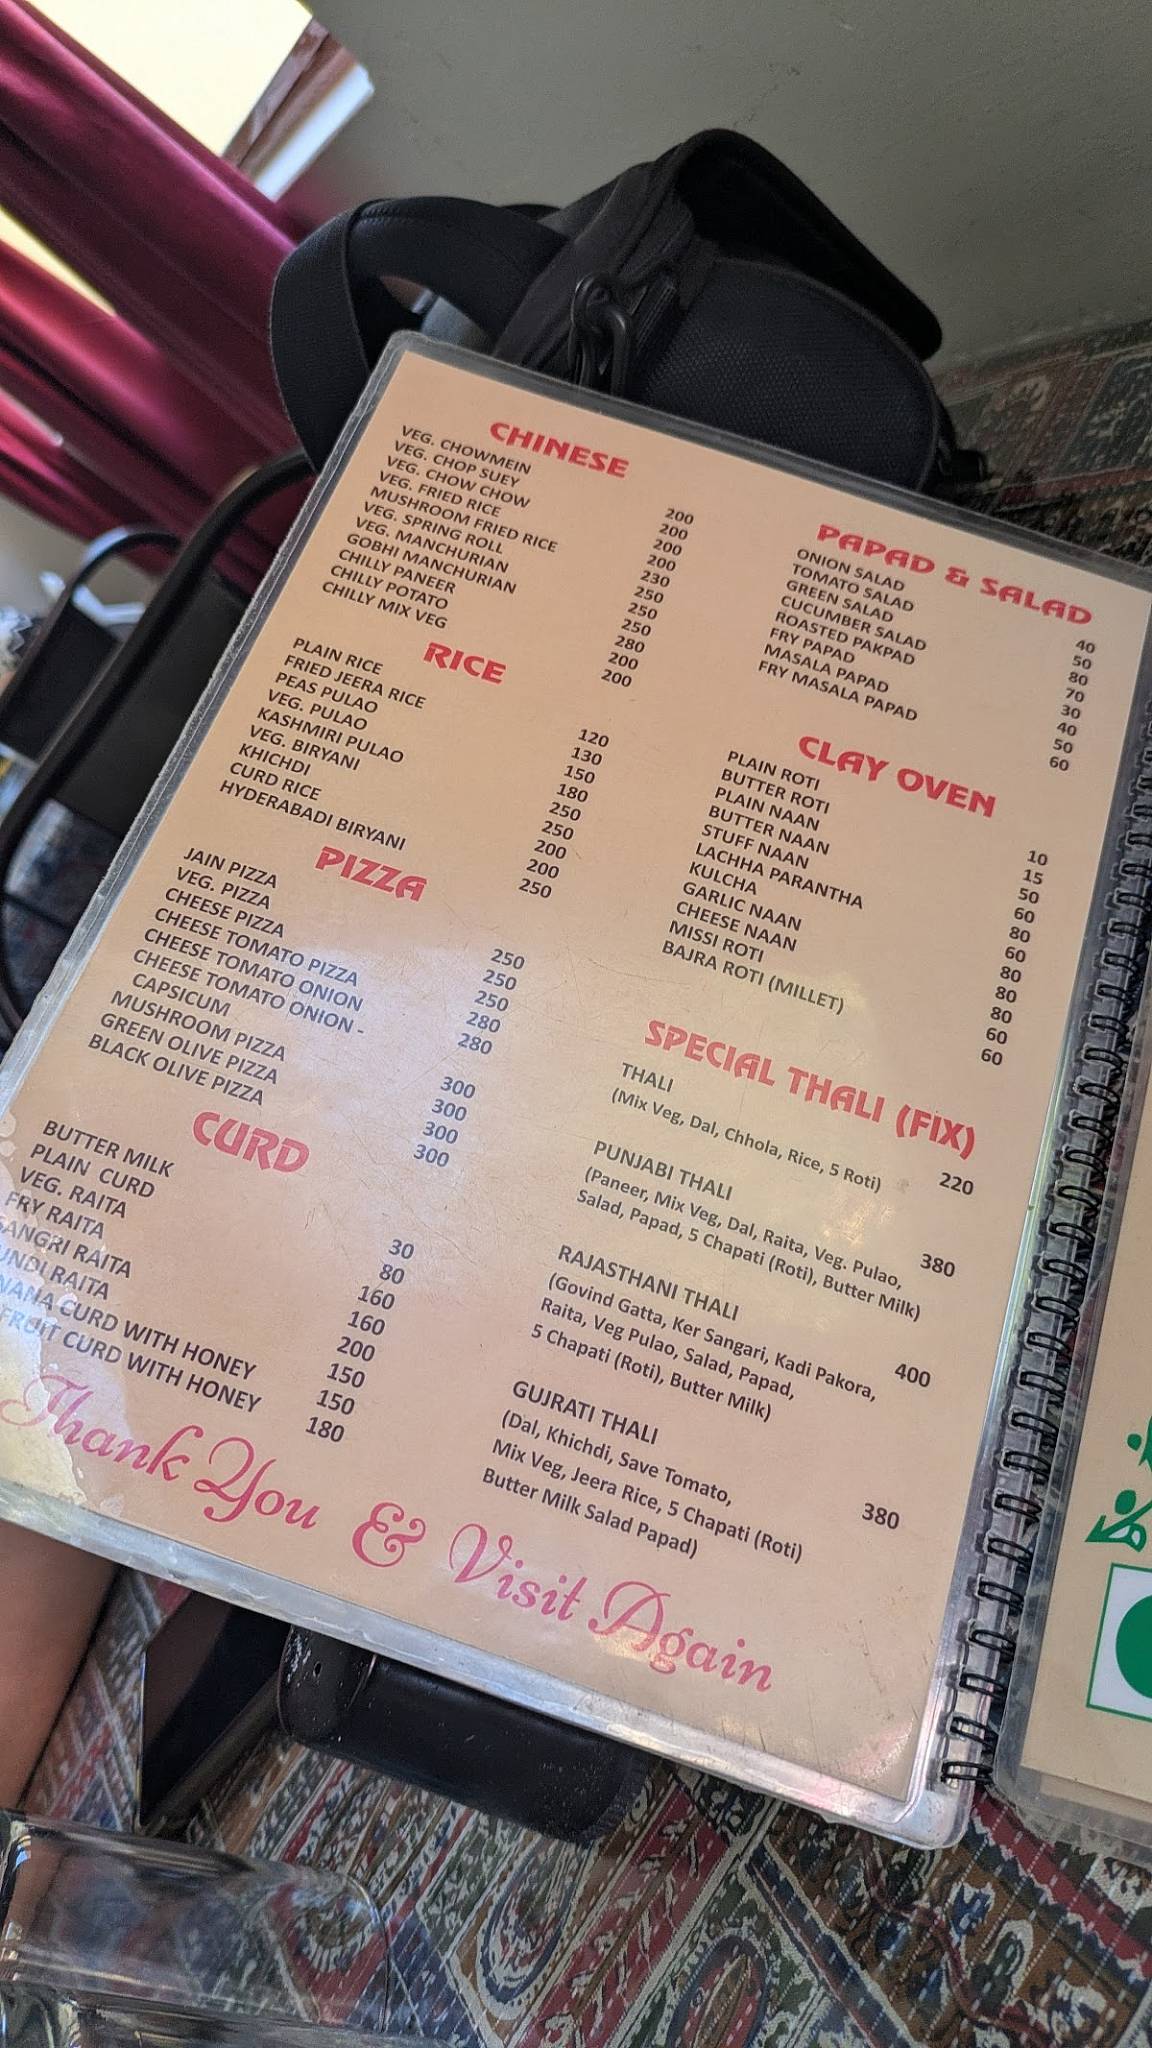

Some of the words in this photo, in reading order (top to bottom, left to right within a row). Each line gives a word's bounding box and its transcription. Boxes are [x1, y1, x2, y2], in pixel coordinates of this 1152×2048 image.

[402, 424, 435, 446] VEG.
[440, 439, 532, 475] CHOWMEIN
[489, 421, 630, 479] CHINESE
[387, 455, 420, 476] VEG.
[425, 468, 478, 492] CHOW
[479, 485, 531, 509] CHOW
[369, 485, 471, 526] MUSHROOM
[473, 517, 520, 540] FRIED
[521, 532, 558, 553] RICE
[664, 507, 695, 525] 200
[356, 516, 390, 538] VEG.
[394, 529, 510, 574] MANCHURIAN
[652, 538, 683, 556] 200
[338, 548, 392, 573] CHILLY
[392, 565, 457, 595] PANEER
[639, 569, 671, 588] 230
[796, 548, 852, 575] ONION
[853, 567, 906, 592] SALAD
[816, 523, 936, 574] PAPAD
[944, 565, 971, 588] &
[979, 577, 1093, 625] SALAD
[322, 581, 376, 606] CHILLY
[376, 597, 413, 618] MIX
[415, 608, 448, 629] VEG
[627, 601, 658, 621] 250
[780, 595, 872, 634] CUCUMBER
[874, 625, 927, 651] SALAD
[292, 636, 343, 663] PLAIN
[344, 653, 384, 676] RICE
[614, 634, 646, 654] 280
[774, 610, 849, 644] ROASTED
[852, 636, 916, 666] PAKPAD
[1075, 639, 1096, 654] 40
[423, 641, 507, 685] RICE
[600, 668, 633, 688] 200
[274, 671, 319, 695] PEAS
[320, 685, 379, 714] PULAO
[758, 659, 790, 679] FRY
[791, 670, 860, 704] MASALA
[863, 694, 918, 721] PAPAD
[1065, 687, 1086, 703] 70
[1060, 704, 1082, 720] 30
[256, 706, 344, 744] KASHMIRI
[344, 735, 405, 763] PULAO
[577, 728, 610, 748] 120
[238, 742, 312, 776] KHICHDI
[563, 764, 596, 785] 150
[727, 750, 778, 777] PLAIN
[780, 767, 821, 792] ROTI
[798, 735, 890, 782] CLAY
[896, 767, 997, 819] OVEN
[1049, 755, 1070, 772] 60
[219, 779, 334, 827] HYDERABADI
[335, 817, 407, 851] BIRYANI
[548, 801, 582, 822] 250
[714, 786, 766, 814] PLAIN
[768, 804, 821, 832] NAAN
[533, 839, 567, 860] 200
[701, 823, 755, 850] STUFF
[757, 841, 810, 870] NAAN
[1027, 849, 1049, 867] 10
[183, 847, 227, 871] JAIN
[227, 861, 277, 889] PIZZA
[315, 845, 428, 902] PIZZA
[518, 877, 553, 899] 250
[688, 861, 757, 896] KULCHA
[165, 887, 233, 920] CHEESE
[233, 909, 284, 939] PIZZA
[1017, 887, 1040, 905] 50
[676, 900, 741, 933] CHEESE
[743, 923, 798, 952] NAAN
[1008, 925, 1031, 944] 80
[490, 948, 525, 970] 250
[661, 939, 717, 971] BAJRA
[722, 960, 765, 986] ROTI
[768, 975, 844, 1016] (MILLET)
[999, 965, 1023, 984] 80
[132, 973, 232, 1017] CAPSICUM
[474, 990, 509, 1012] 250
[989, 1006, 1013, 1025] 80
[110, 990, 232, 1043] MUSHROOM
[233, 1032, 285, 1062] PIZZA
[87, 1033, 151, 1067] BLACK
[152, 1056, 210, 1087] OLIVE
[210, 1075, 263, 1106] PIZZA
[622, 1062, 674, 1093] THALI
[980, 1048, 1004, 1066] 60
[440, 1076, 476, 1099] 300
[644, 1019, 776, 1087] SPECIAL
[787, 1066, 885, 1123] THALI
[895, 1104, 976, 1161] (FIX)
[431, 1098, 468, 1122] 300
[42, 1119, 120, 1160] BUTTER
[122, 1147, 175, 1178] MILK
[193, 1111, 310, 1173] CURD
[413, 1144, 450, 1168] 300
[611, 1087, 648, 1112] (Mix
[653, 1101, 685, 1127] Veg,
[689, 1114, 719, 1139] Dal,
[724, 1127, 783, 1160] Chhola,
[787, 1148, 824, 1175] Rice,
[828, 1162, 840, 1177] 5
[843, 1167, 881, 1194] Roti)
[593, 1140, 675, 1181] PUNJABI
[679, 1168, 733, 1201] THALI
[938, 1171, 975, 1196] 220
[20, 1165, 62, 1197] VEG.
[68, 1185, 127, 1219] RAITA
[5, 1191, 46, 1216] FRY
[45, 1205, 104, 1240] RAITA
[388, 1238, 415, 1260] 30
[576, 1189, 624, 1220] Salad,
[629, 1207, 683, 1240] Papad,
[688, 1227, 699, 1242] 5
[702, 1233, 766, 1266] Chapati
[768, 1254, 817, 1287] (Roti),
[822, 1274, 875, 1304] Butter
[878, 1293, 921, 1323] Milk)
[919, 1253, 956, 1278] 380
[357, 1285, 395, 1310] 160
[558, 1244, 679, 1300] RAJASTHANI
[684, 1287, 740, 1322] THALI
[347, 1310, 386, 1336] 160
[548, 1272, 615, 1308] (Govind
[617, 1298, 667, 1330] Gatta,
[672, 1316, 702, 1338] Ker
[703, 1327, 769, 1366] Sangari,
[774, 1352, 812, 1378] Kadi
[814, 1365, 876, 1403] Pakora,
[336, 1335, 376, 1362] 200
[326, 1362, 366, 1389] 150
[894, 1363, 932, 1388] 400
[316, 1389, 356, 1416] 150
[512, 1380, 596, 1423] GUJRATI
[601, 1408, 659, 1445] THALI
[305, 1416, 345, 1443] 180
[501, 1409, 541, 1440] (Dal,
[546, 1425, 614, 1465] Khichdi,
[618, 1451, 659, 1478] Save
[665, 1466, 732, 1508] Tomato,
[0, 1374, 204, 1481] Thank
[193, 1436, 320, 1530] You
[351, 1502, 427, 1568] &
[449, 1523, 588, 1621] Visit
[588, 1580, 772, 1692] Again
[482, 1467, 539, 1499] Butter
[541, 1488, 582, 1516] Milk
[584, 1503, 634, 1534] Salad
[636, 1521, 698, 1560] Papad)
[861, 1502, 900, 1530] 380
